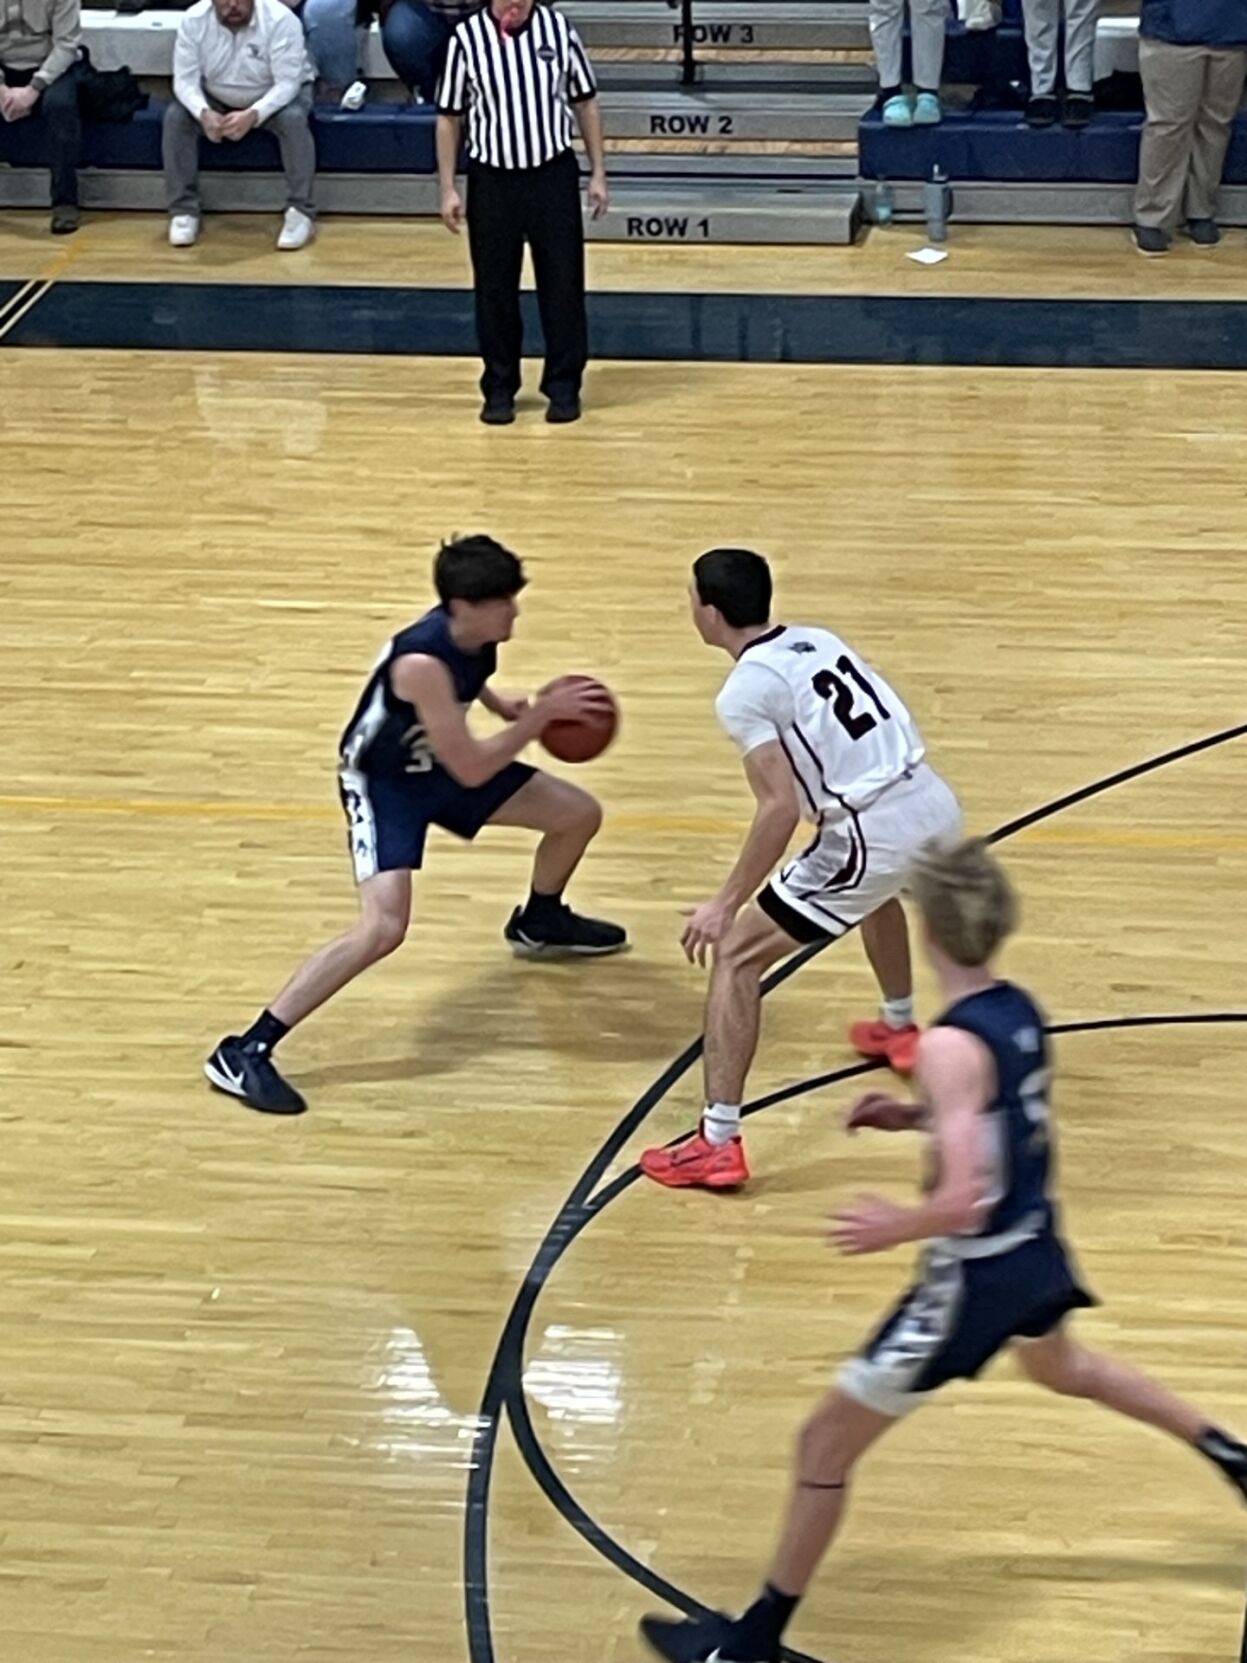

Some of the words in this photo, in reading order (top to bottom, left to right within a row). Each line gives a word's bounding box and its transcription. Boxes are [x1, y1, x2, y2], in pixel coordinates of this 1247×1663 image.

[739, 25, 754, 43] 3
[650, 115, 709, 134] ROW
[718, 116, 733, 134] 2
[627, 217, 688, 237] ROW
[697, 218, 710, 237] 1
[811, 654, 891, 741] 21
